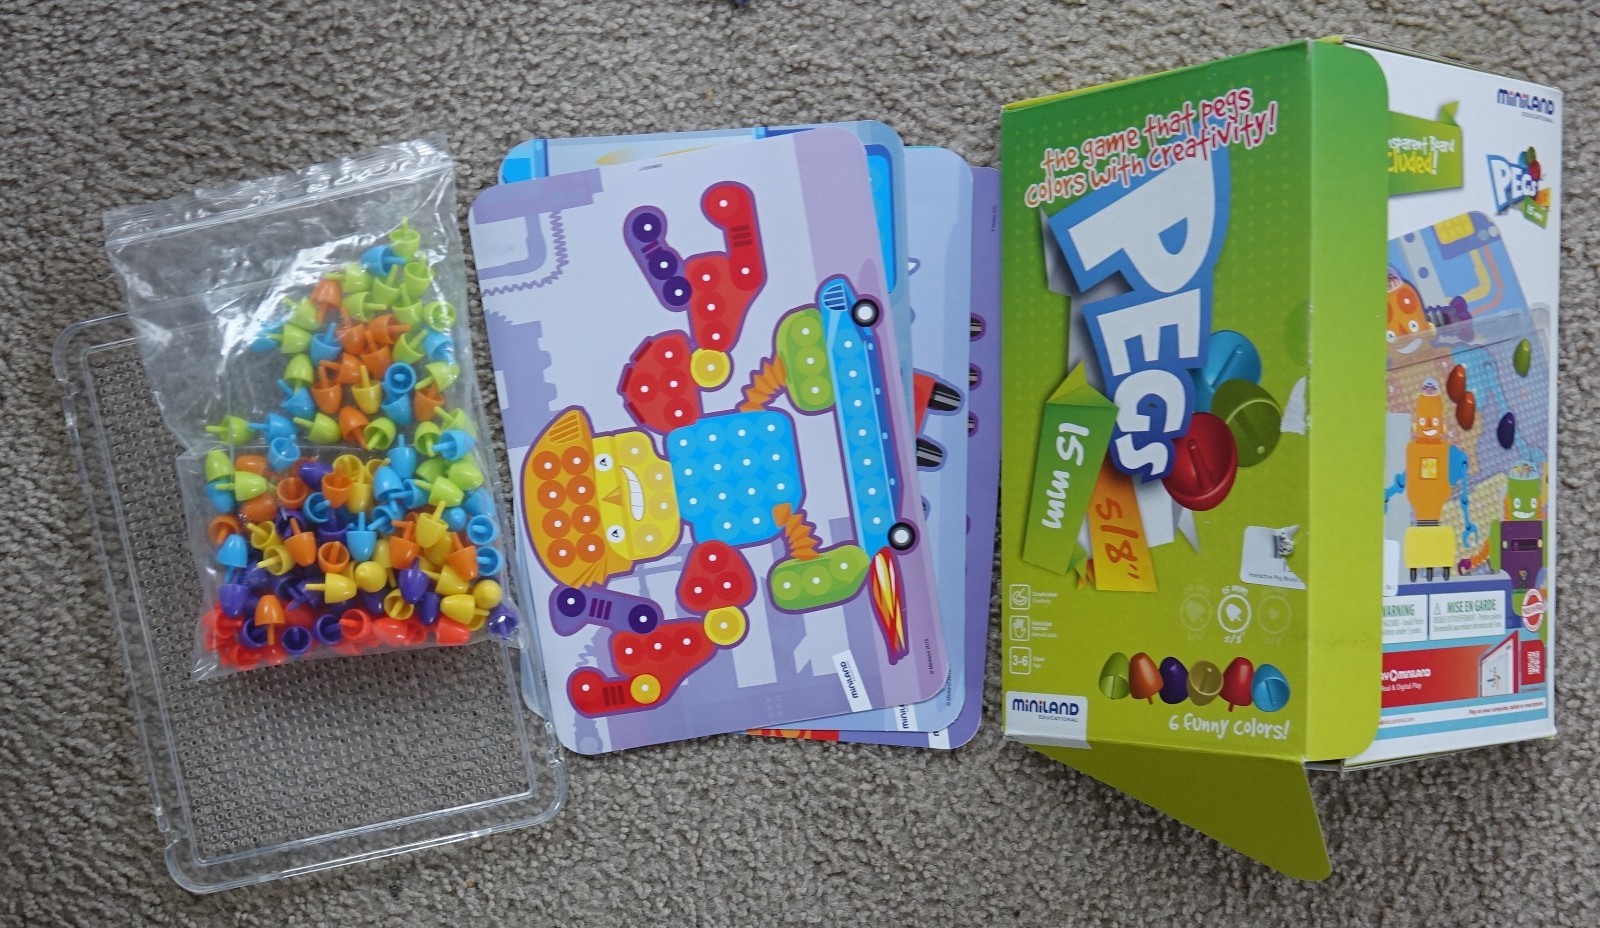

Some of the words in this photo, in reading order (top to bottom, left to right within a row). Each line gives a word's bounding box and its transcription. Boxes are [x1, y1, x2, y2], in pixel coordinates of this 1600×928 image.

[1025, 173, 1086, 207] colors
[1090, 154, 1145, 188] with
[1149, 101, 1278, 170] creativity!
[1042, 148, 1077, 174] the
[1082, 127, 1139, 168] game
[1144, 102, 1196, 148] that
[1201, 88, 1252, 124] pegs
[1487, 156, 1538, 210] PEGS
[1056, 150, 1222, 478] PEGS
[1056, 422, 1090, 466] 15
[1041, 470, 1070, 529] mm
[1447, 601, 1463, 613] MISE
[1464, 600, 1473, 612] EN
[1475, 599, 1496, 611] GARDE
[1012, 654, 1029, 667] 3-6
[1039, 714, 1079, 722] EDUCATIONAL
[1169, 715, 1179, 730] 6
[1183, 712, 1229, 739] funny
[1233, 717, 1290, 740] colors!
